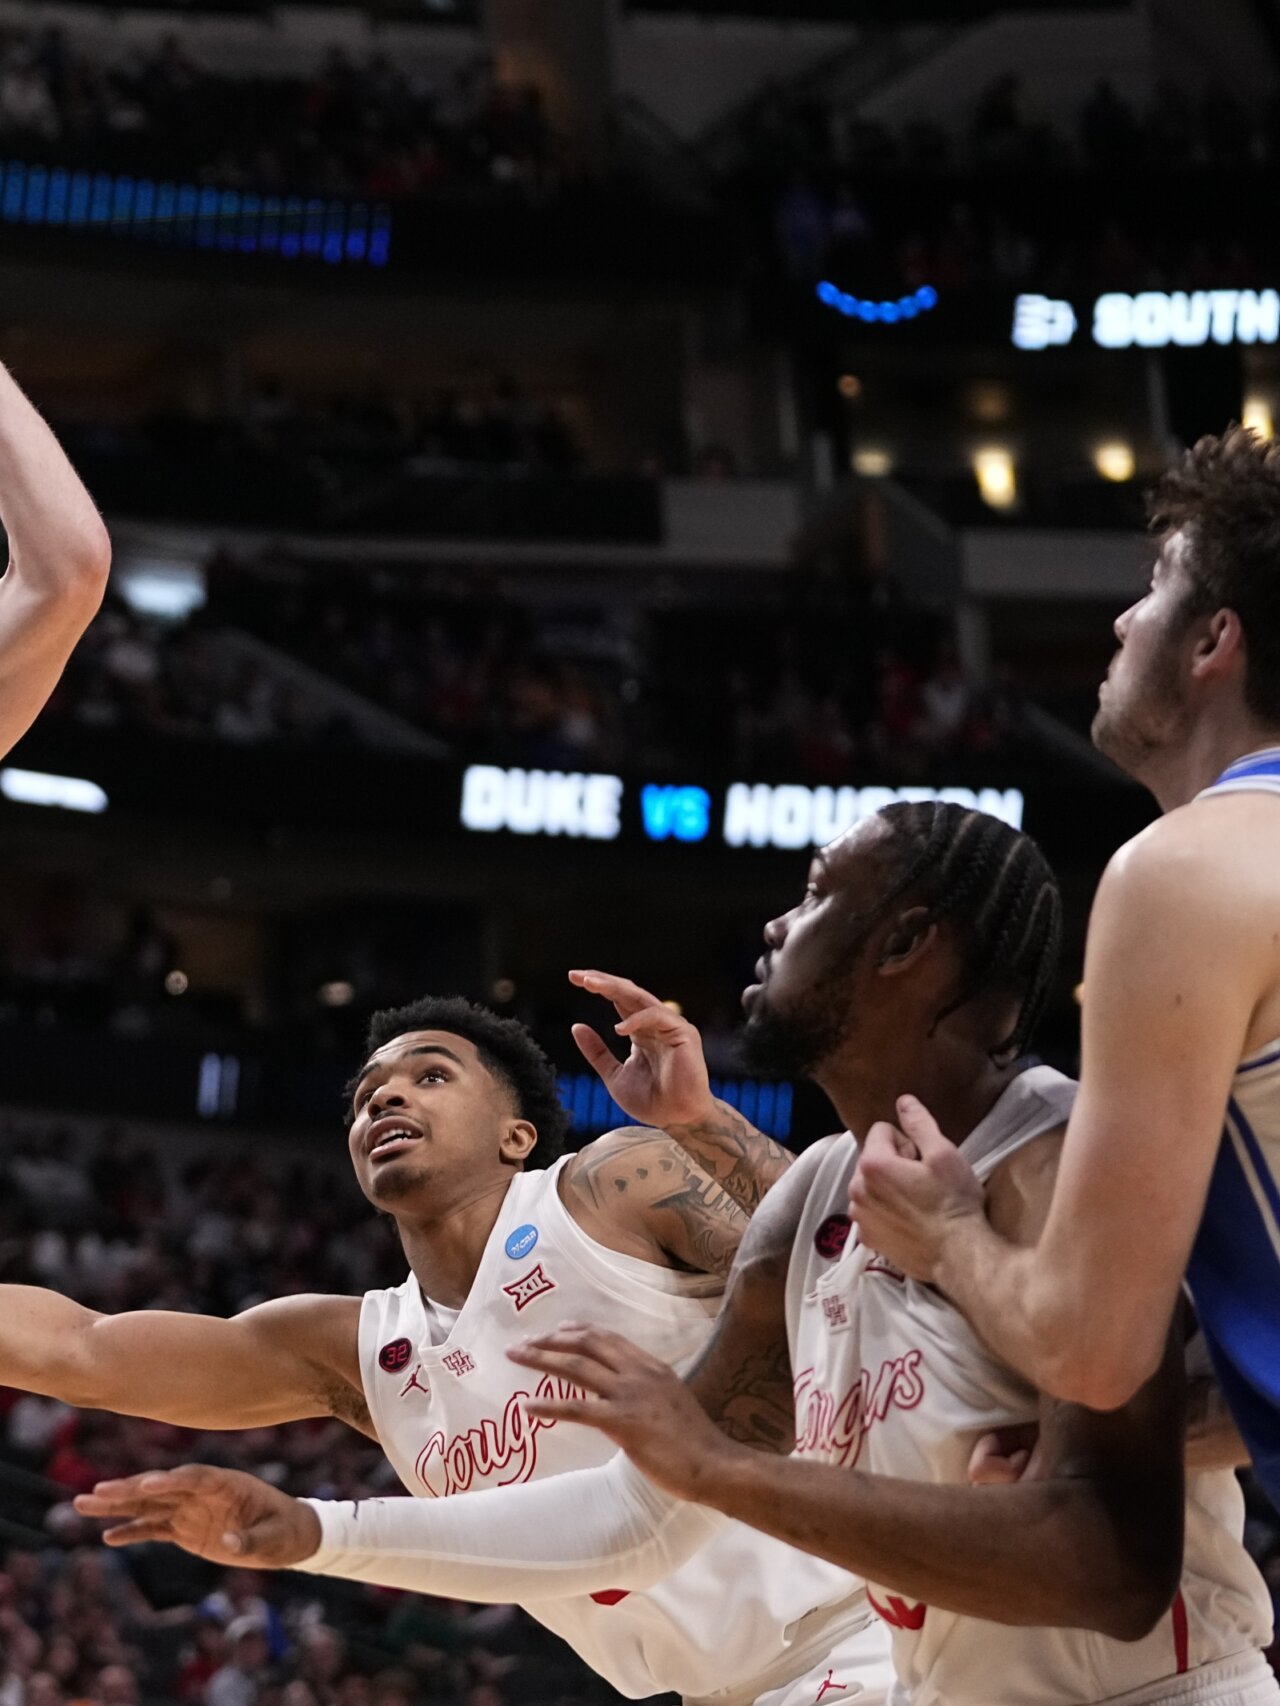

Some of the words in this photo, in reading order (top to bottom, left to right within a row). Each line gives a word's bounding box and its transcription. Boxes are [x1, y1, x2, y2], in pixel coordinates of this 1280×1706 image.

[1092, 288, 1280, 348] SOUTH
[460, 765, 623, 840] DUKE
[640, 783, 710, 841] VS
[723, 782, 1024, 850] HOUN
[385, 1343, 408, 1366] 32
[415, 1374, 588, 1498] Couga
